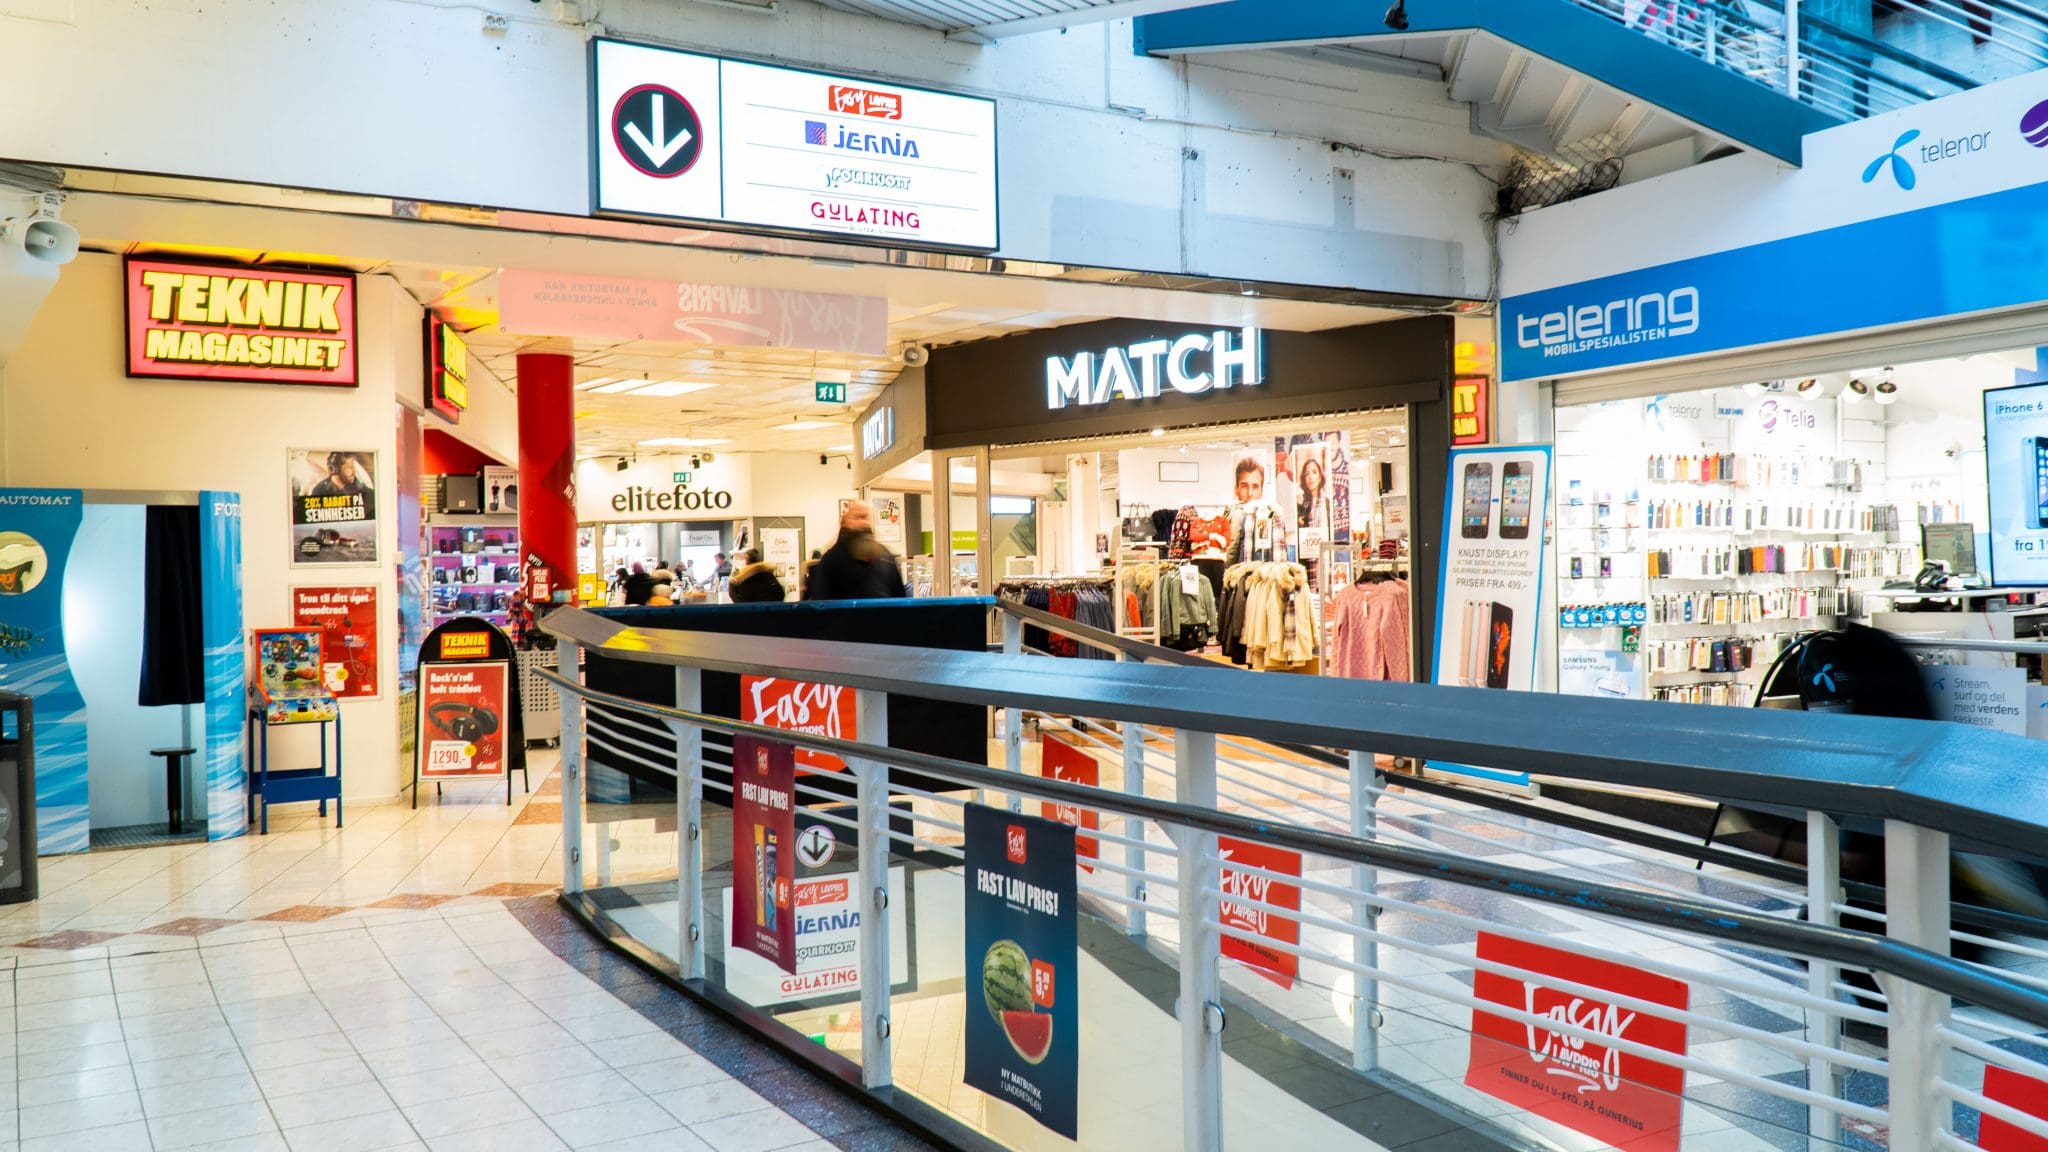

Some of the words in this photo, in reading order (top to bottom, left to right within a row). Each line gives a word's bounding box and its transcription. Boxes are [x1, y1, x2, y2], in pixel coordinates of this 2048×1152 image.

[1920, 127, 1992, 164] telenor
[811, 202, 920, 229] GULATING
[143, 271, 344, 333] TEKNIK
[1517, 286, 1700, 349] telering
[145, 329, 346, 369] MAGASINET
[1544, 327, 1666, 358] MOBILSPESIALISTEN
[1047, 326, 1263, 410] MATCH
[1995, 403, 2033, 415] iPhone
[2037, 401, 2043, 411] 6
[1783, 408, 1815, 429] Telia
[304, 497, 322, 509] 20%
[323, 495, 351, 508] RABATT
[353, 493, 364, 506] PÅ
[611, 484, 732, 512] elitefoto
[305, 506, 365, 522] SENNHEISER
[2015, 539, 2033, 551] fra
[1458, 548, 1485, 558] KNUST
[1487, 549, 1529, 559] DISPLAY?
[1456, 578, 1485, 588] PRISER
[1487, 579, 1505, 589] FRA
[320, 593, 330, 604] til
[332, 593, 348, 604] ditt
[299, 604, 349, 616] soundtrack
[443, 634, 487, 648] TEKNIK
[1563, 656, 1598, 664] SAMSUNG
[430, 684, 447, 694] helt
[1954, 677, 1992, 690] Stream,
[1953, 690, 1973, 701] surf
[1975, 692, 1987, 704] og
[1989, 691, 2006, 702] del
[1953, 703, 1976, 714] med
[1978, 704, 2020, 716] verdens
[1953, 714, 1995, 726] raskeste
[432, 749, 467, 765] 1290,-
[742, 781, 758, 802] FAST
[757, 785, 769, 806] LAV
[769, 788, 789, 811] PRIS!
[977, 867, 1005, 898] FAST
[1005, 876, 1026, 905] LAV
[1026, 883, 1059, 917] PRIS!
[781, 969, 858, 993] GULATING
[1001, 1066, 1011, 1079] NY
[1010, 1070, 1042, 1099] MATBUTIKK
[1004, 1084, 1042, 1113] UNDERETASJEN
[1500, 1066, 1530, 1085] FINNER
[1531, 1077, 1544, 1091] DU
[1545, 1082, 1550, 1093] I
[1583, 1098, 1595, 1111] PÅ
[1597, 1105, 1644, 1131] GUNERIUS
